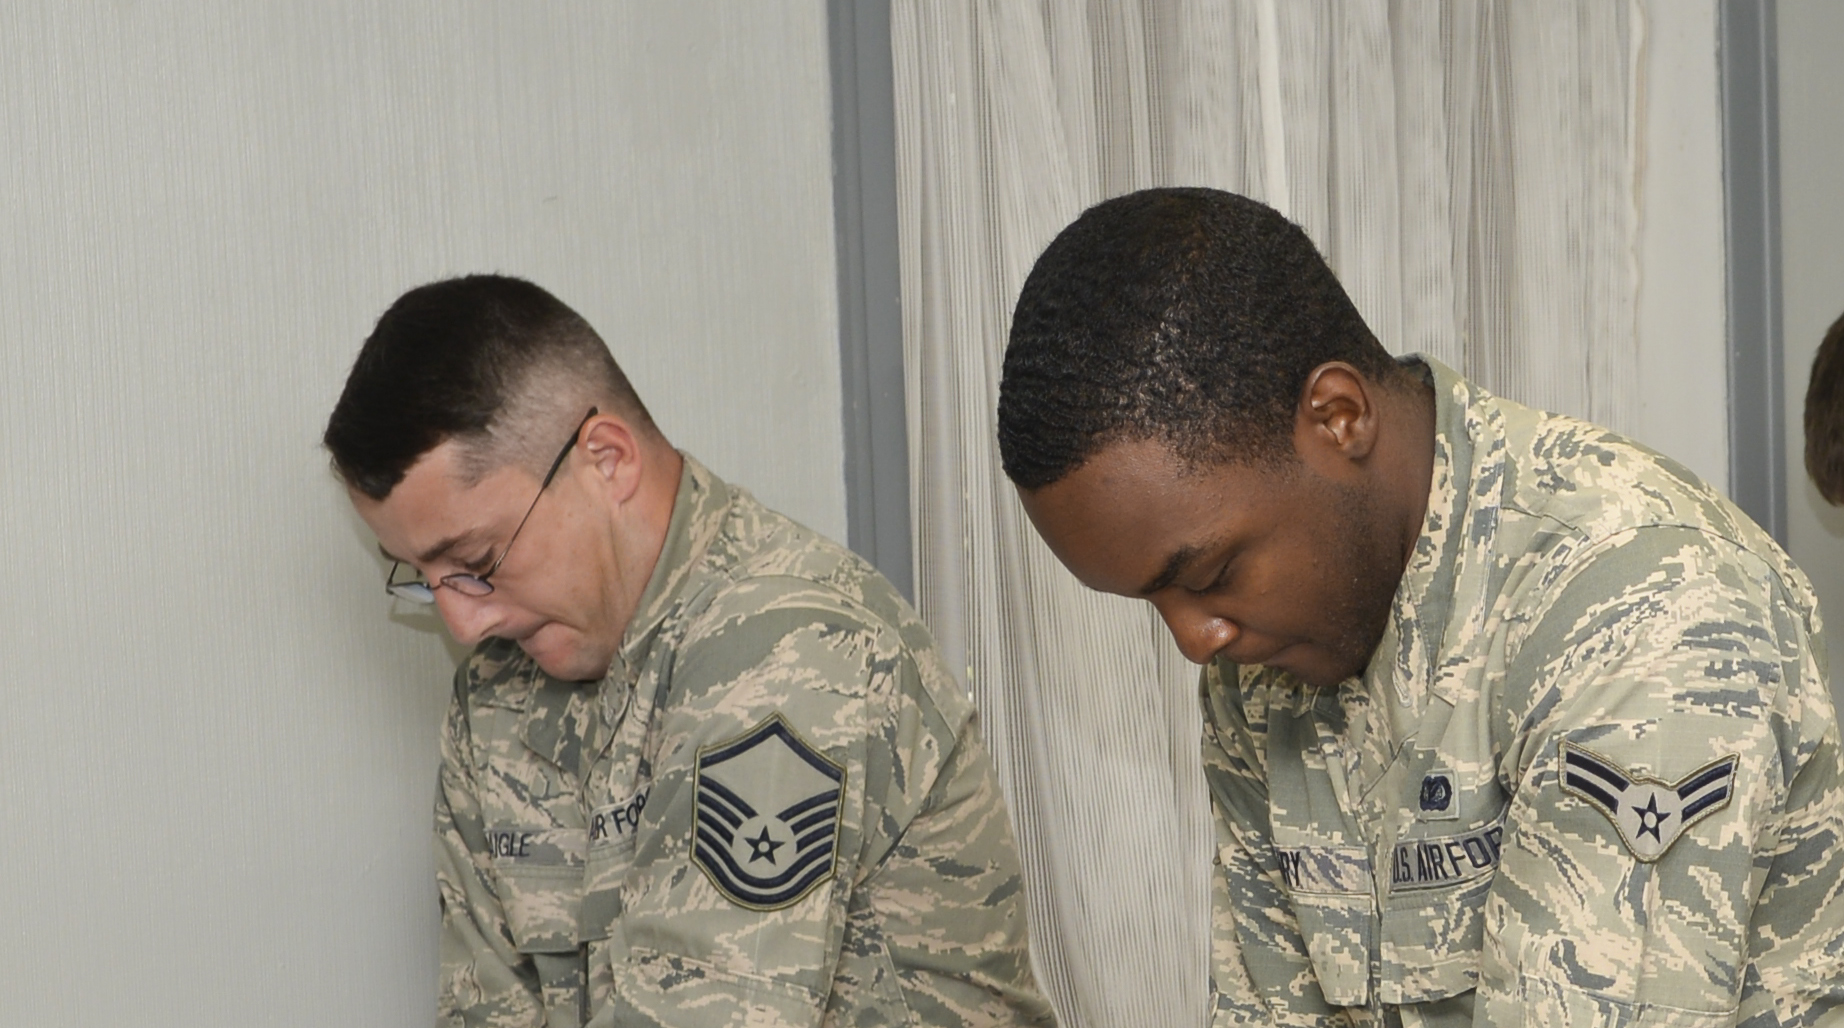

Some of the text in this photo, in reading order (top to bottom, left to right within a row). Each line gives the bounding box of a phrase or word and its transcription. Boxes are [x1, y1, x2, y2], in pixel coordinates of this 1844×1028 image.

[611, 786, 650, 834] FOR
[1277, 850, 1301, 887] RY
[1392, 826, 1503, 883] U.S. AIR FOR
